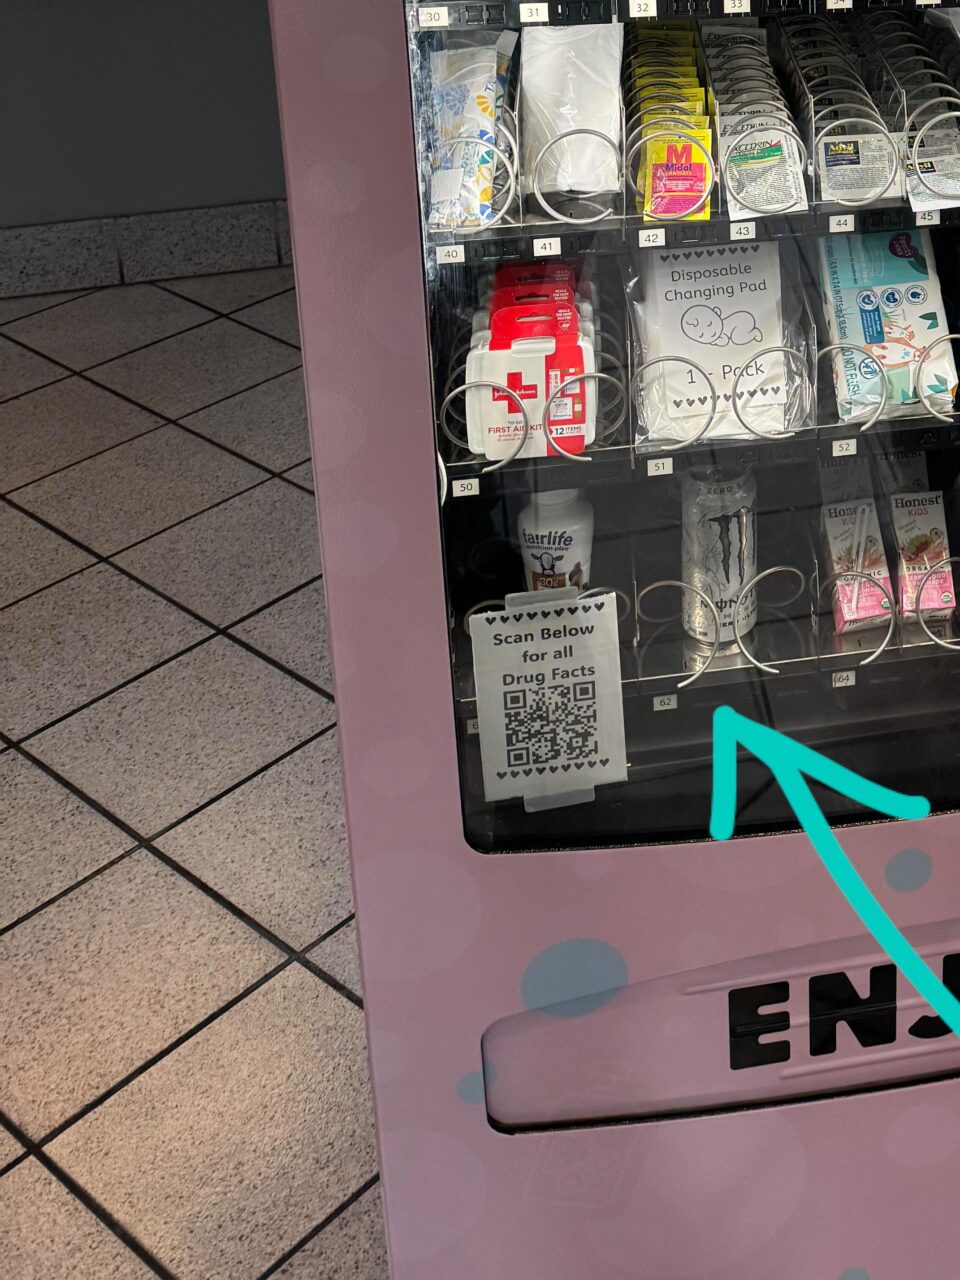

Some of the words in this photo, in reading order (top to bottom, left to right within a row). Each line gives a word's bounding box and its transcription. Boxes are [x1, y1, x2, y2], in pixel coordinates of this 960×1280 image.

[636, 3, 649, 13] 32
[730, 0, 743, 9] 33
[426, 12, 440, 22] 30
[527, 8, 539, 18] 31
[666, 143, 693, 164] M
[665, 163, 693, 172] Midol
[920, 212, 934, 221] 45
[835, 219, 848, 228] 44
[735, 226, 750, 236] 43
[644, 233, 659, 243] 42
[540, 242, 553, 251] 41
[444, 249, 458, 259] 40
[670, 262, 752, 282] Disposable
[664, 285, 735, 303] Changing
[739, 278, 768, 293] Pad
[845, 357, 856, 372] NOT
[686, 368, 697, 384] 1
[488, 426, 512, 434] FIRST
[529, 423, 543, 432] KIT
[554, 427, 565, 436] 12
[565, 425, 582, 433] ITEMS
[838, 443, 850, 453] 52
[654, 462, 666, 472] 51
[460, 483, 473, 492] 50
[894, 495, 941, 509] Honest
[493, 631, 535, 646] Scan
[541, 623, 595, 641] Below
[521, 650, 548, 664] for
[552, 645, 574, 659] all
[502, 672, 546, 687] Drug
[551, 665, 596, 680] Facts
[659, 697, 672, 707] 62
